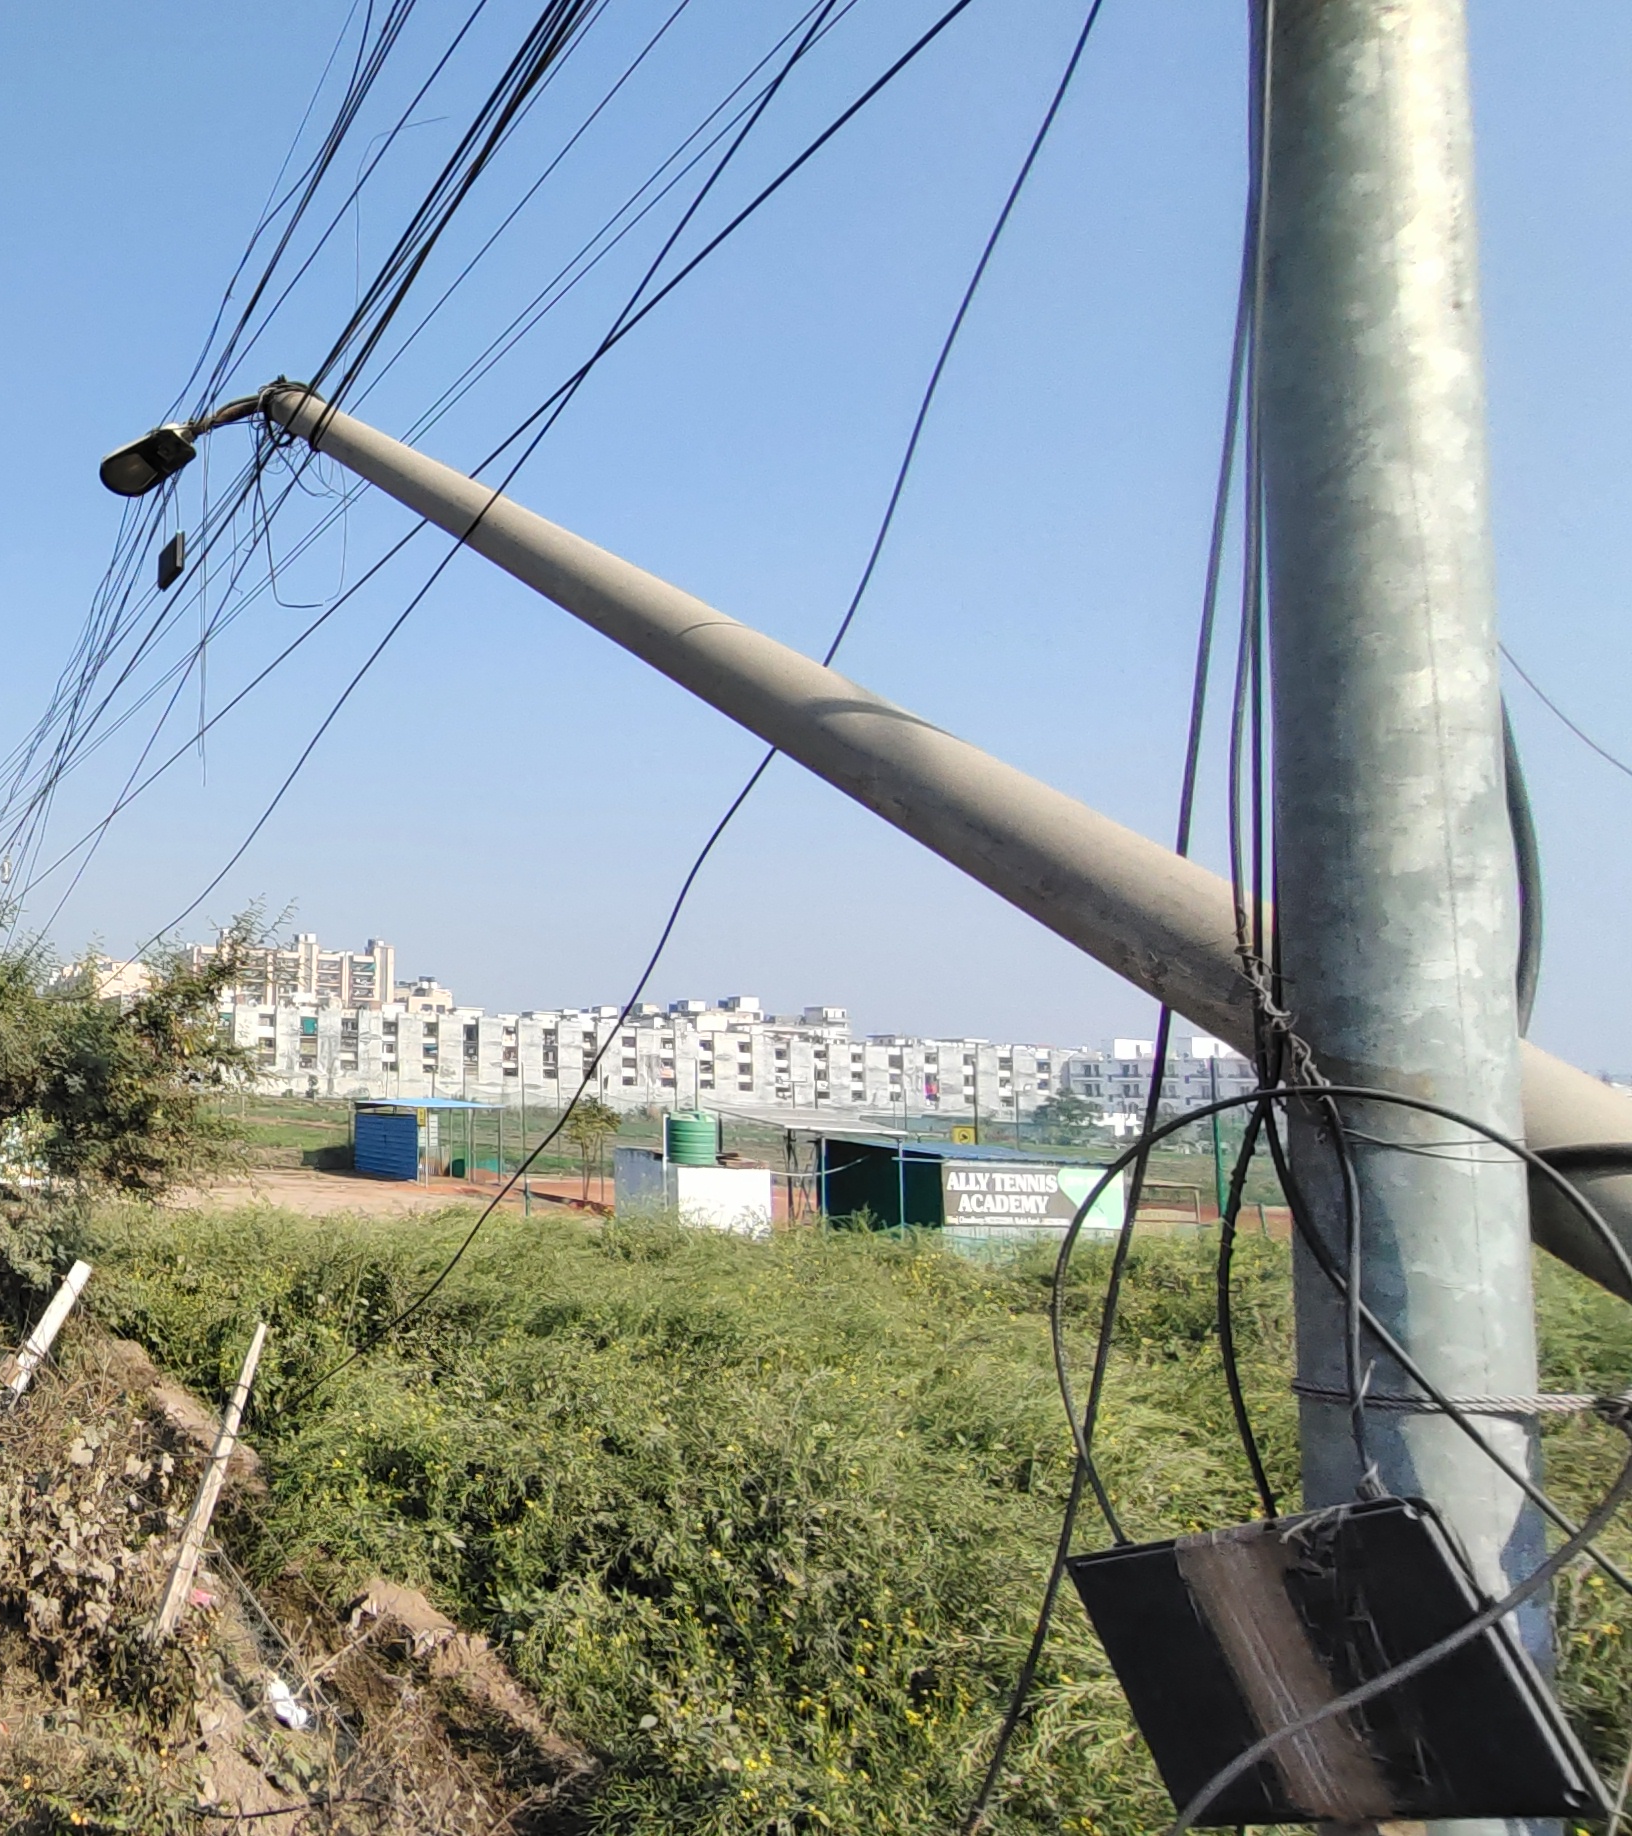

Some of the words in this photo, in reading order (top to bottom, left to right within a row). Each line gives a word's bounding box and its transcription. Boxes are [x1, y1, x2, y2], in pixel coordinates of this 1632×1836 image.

[946, 1171, 990, 1191] ALLY
[992, 1173, 1058, 1193] TENNIS
[958, 1194, 1049, 1214] ACADEMY
